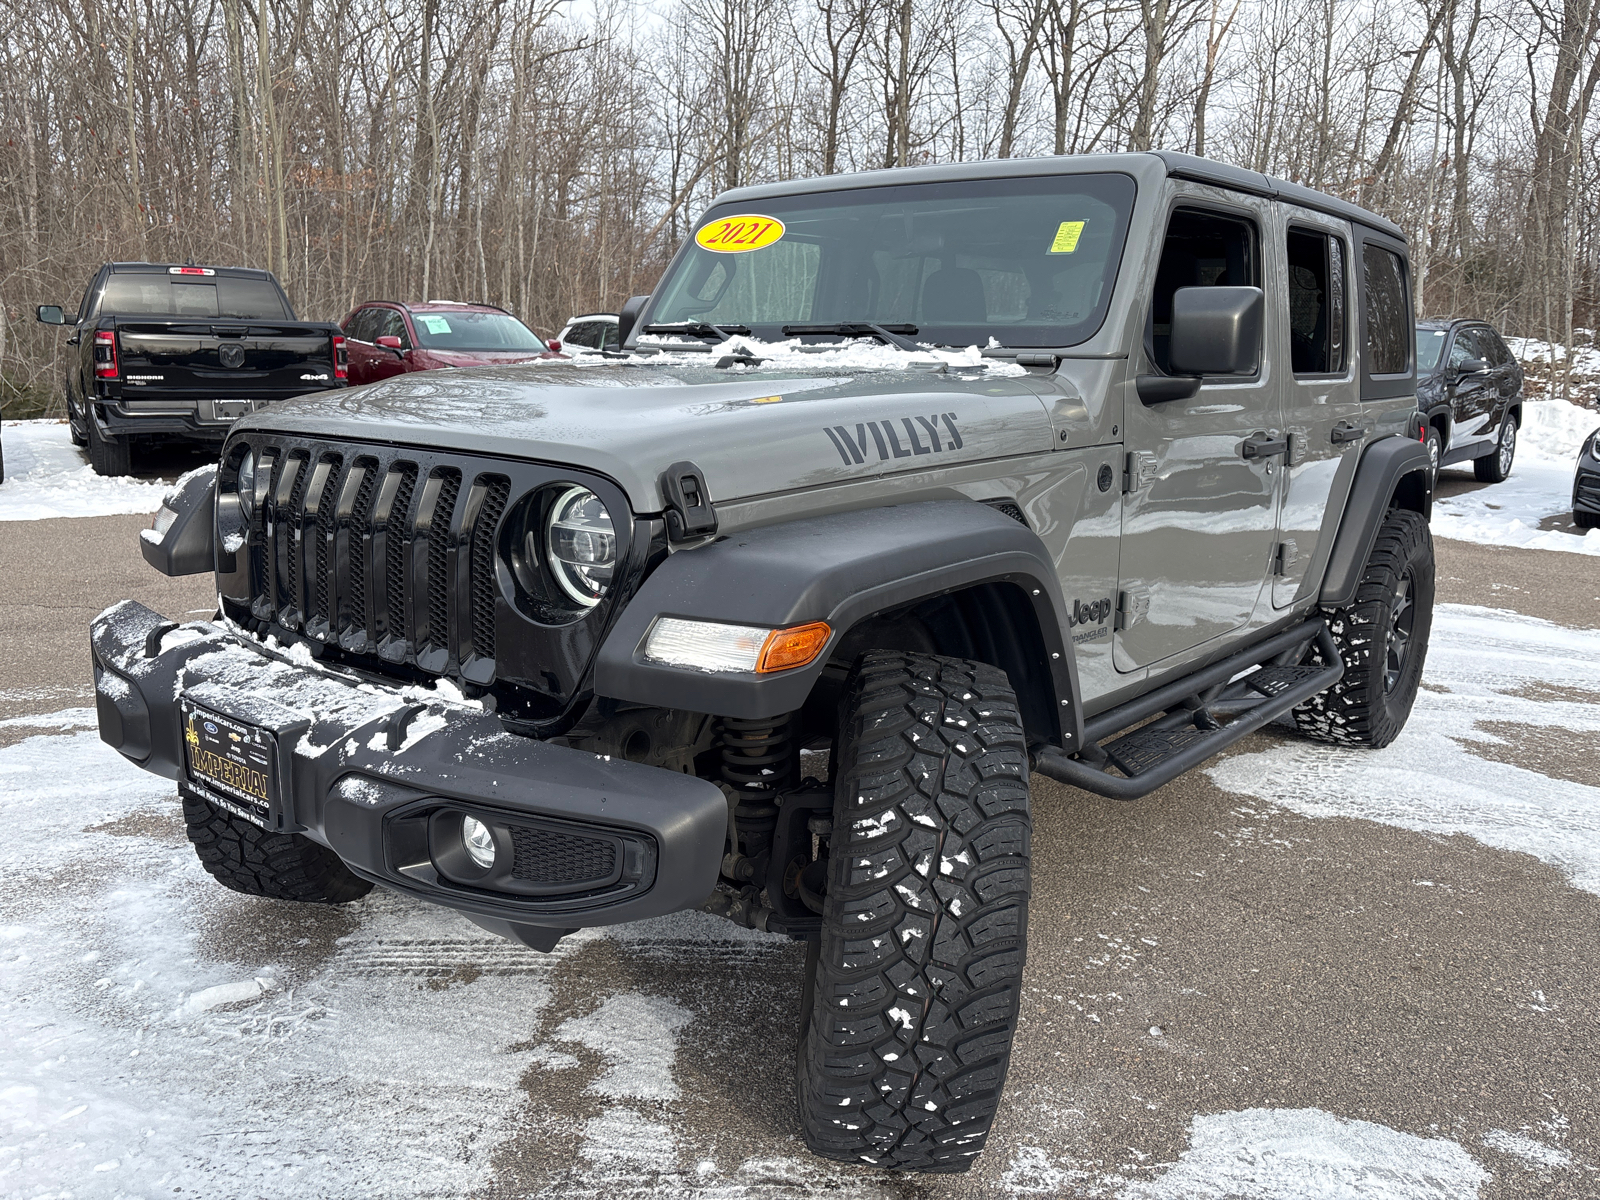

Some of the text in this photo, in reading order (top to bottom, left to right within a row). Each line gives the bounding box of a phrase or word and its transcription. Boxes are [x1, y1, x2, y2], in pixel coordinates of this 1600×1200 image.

[705, 222, 774, 244] 2021
[822, 412, 964, 466] WILLYS
[1067, 597, 1111, 628] Jeep
[188, 782, 196, 793] We
[197, 787, 206, 798] Sell
[227, 802, 237, 814] You
[237, 808, 250, 821] Save
